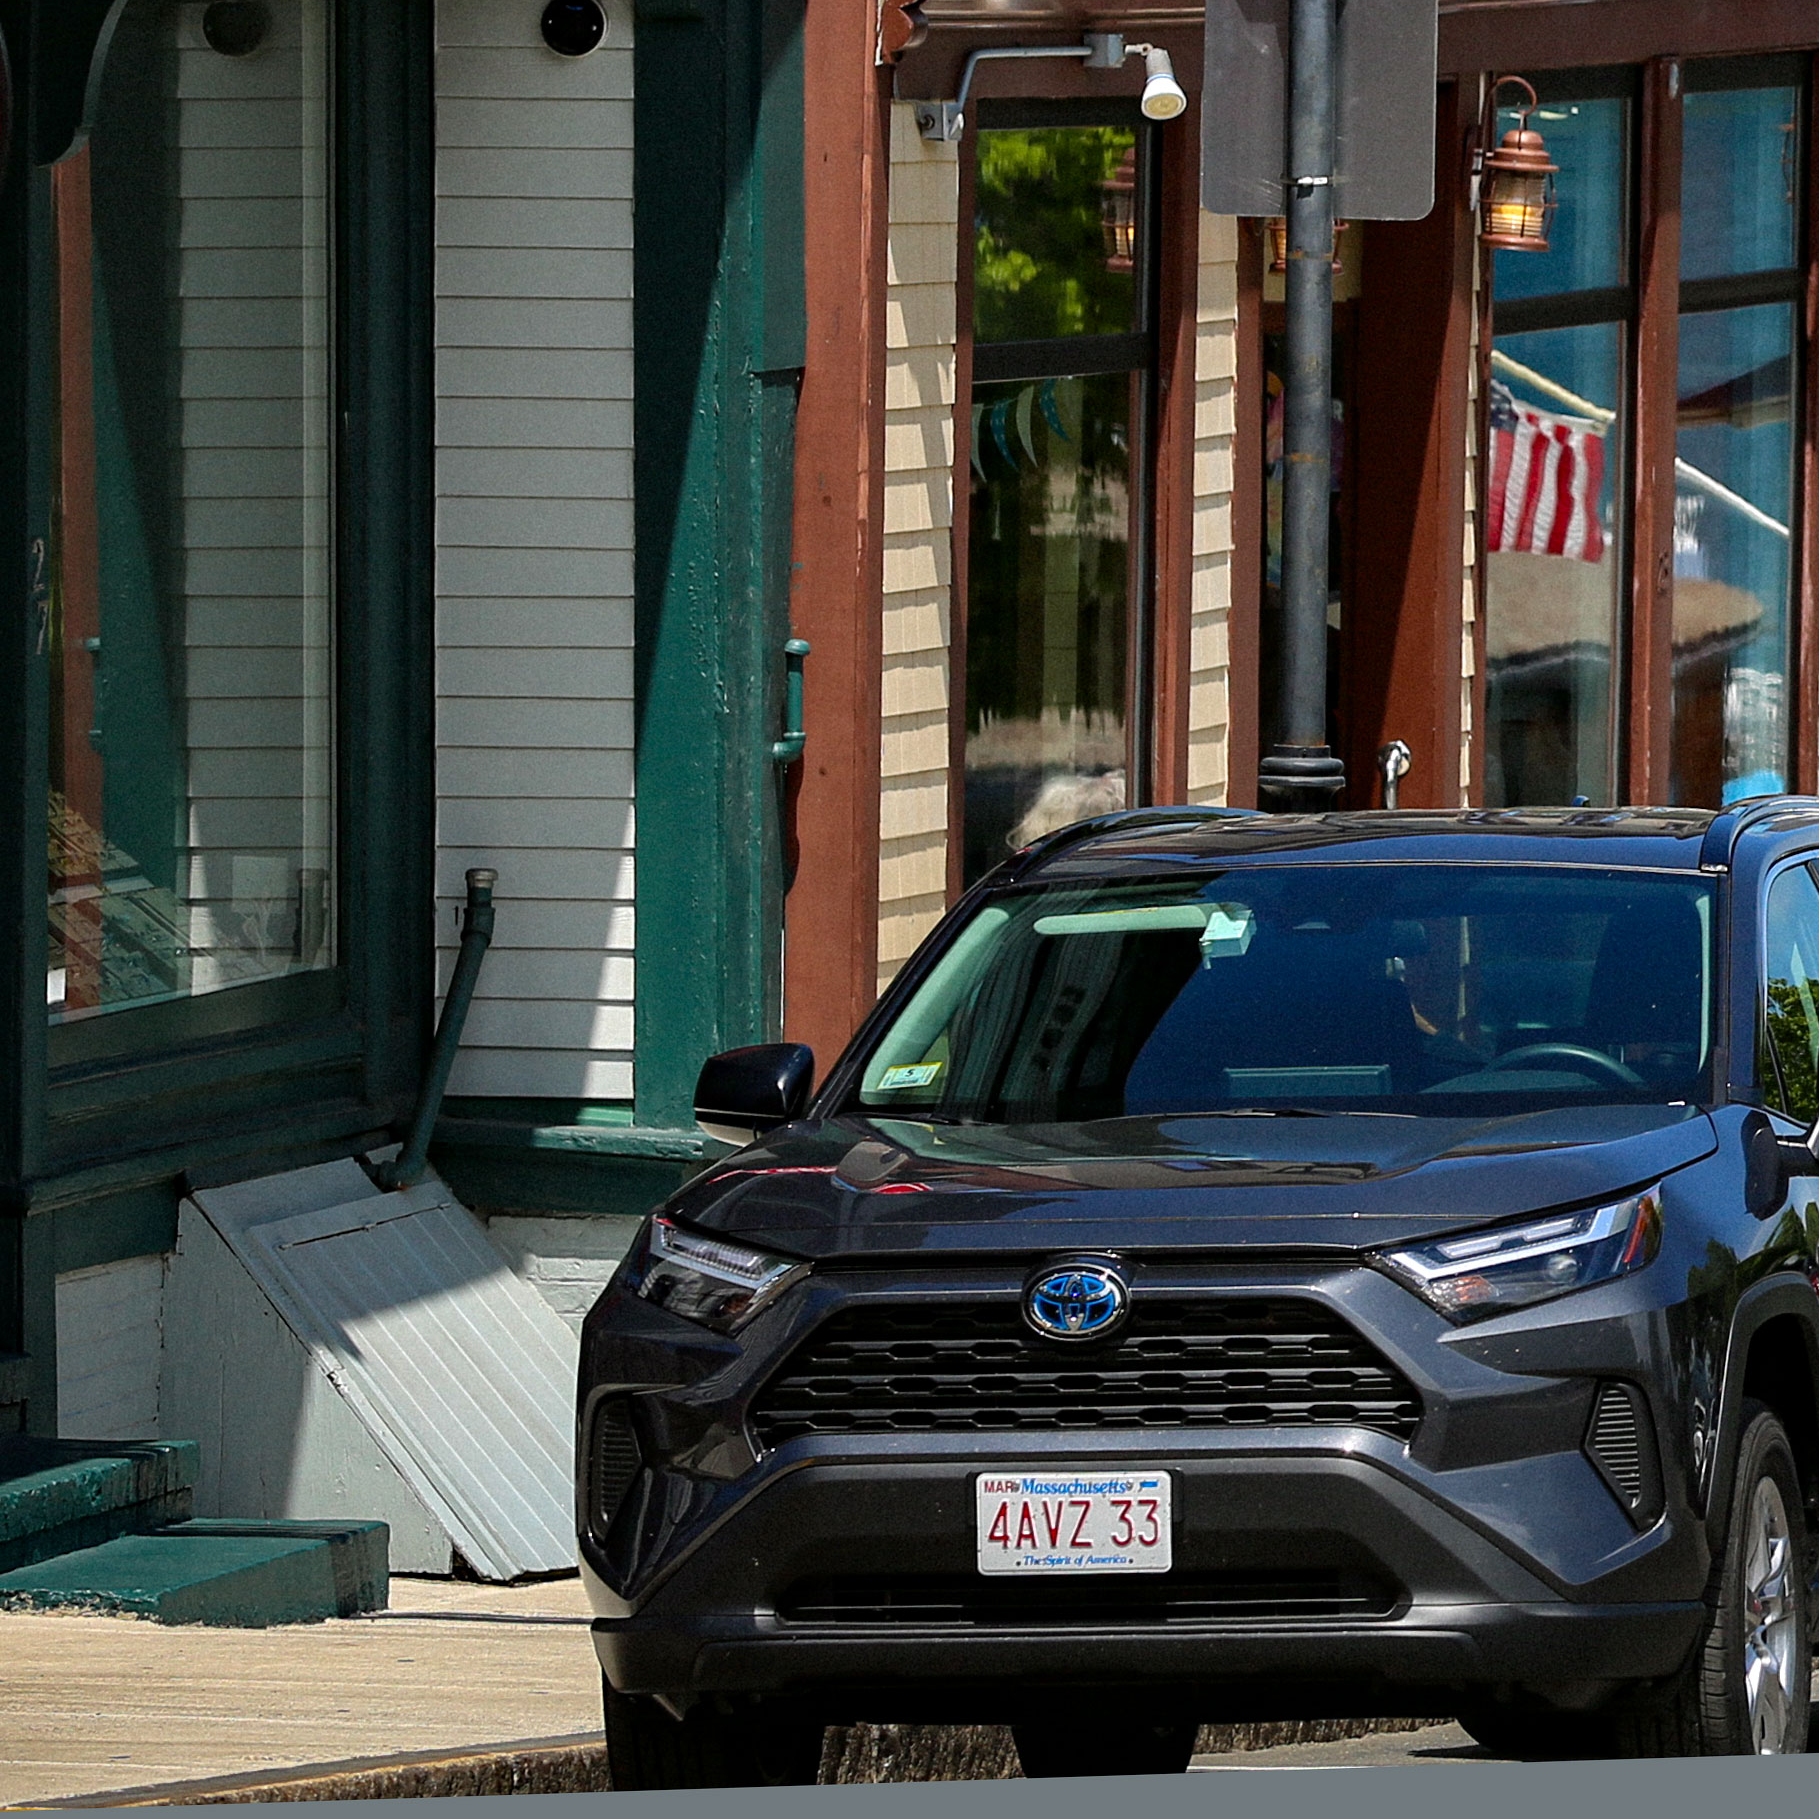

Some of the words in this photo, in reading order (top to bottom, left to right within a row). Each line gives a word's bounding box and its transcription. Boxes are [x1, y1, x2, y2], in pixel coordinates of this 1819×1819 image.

[1020, 1478, 1127, 1496] Massachusetts
[988, 1501, 1093, 1549] 4AVZ
[1110, 1500, 1161, 1547] 33
[1045, 1555, 1071, 1568] Spirit
[1074, 1555, 1085, 1566] of
[1086, 1555, 1127, 1565] America
